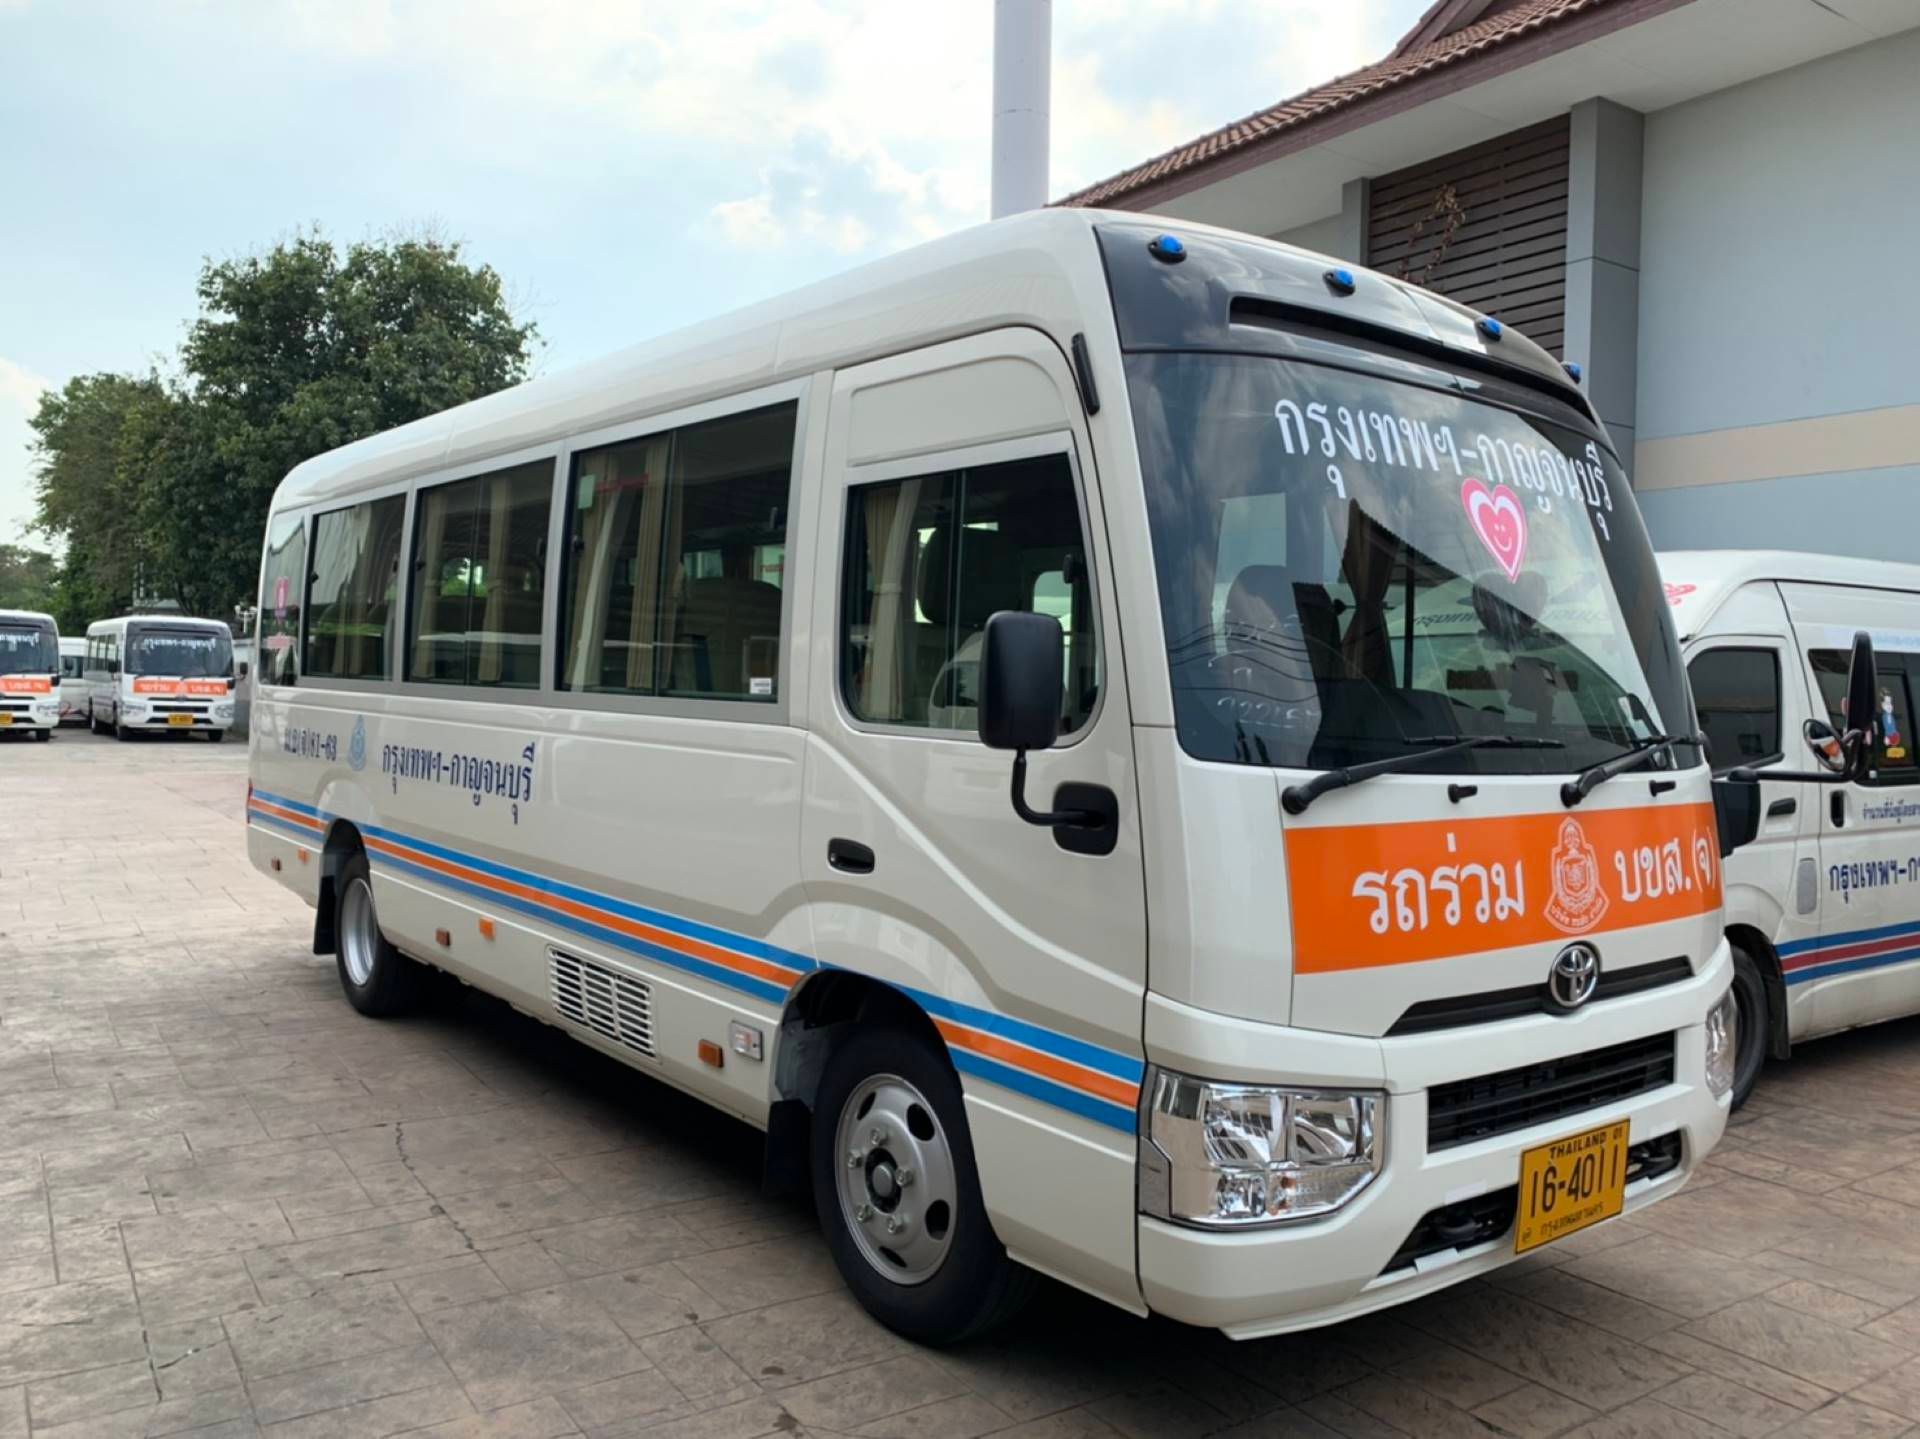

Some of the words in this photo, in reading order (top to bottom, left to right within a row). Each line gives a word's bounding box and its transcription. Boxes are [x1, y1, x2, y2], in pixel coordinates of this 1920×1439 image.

[1274, 398, 1613, 541] กรุงเทพฯ-กาญจนบุรี
[382, 741, 536, 825] กรุงเทพฯ-กาญจนบุรี
[1351, 832, 1526, 935] รถร่วม
[1829, 856, 1920, 904] กรุงเทพฯ-ก
[1530, 1144, 1619, 1218] 16-4011
[1549, 1131, 1607, 1160] THAILAND
